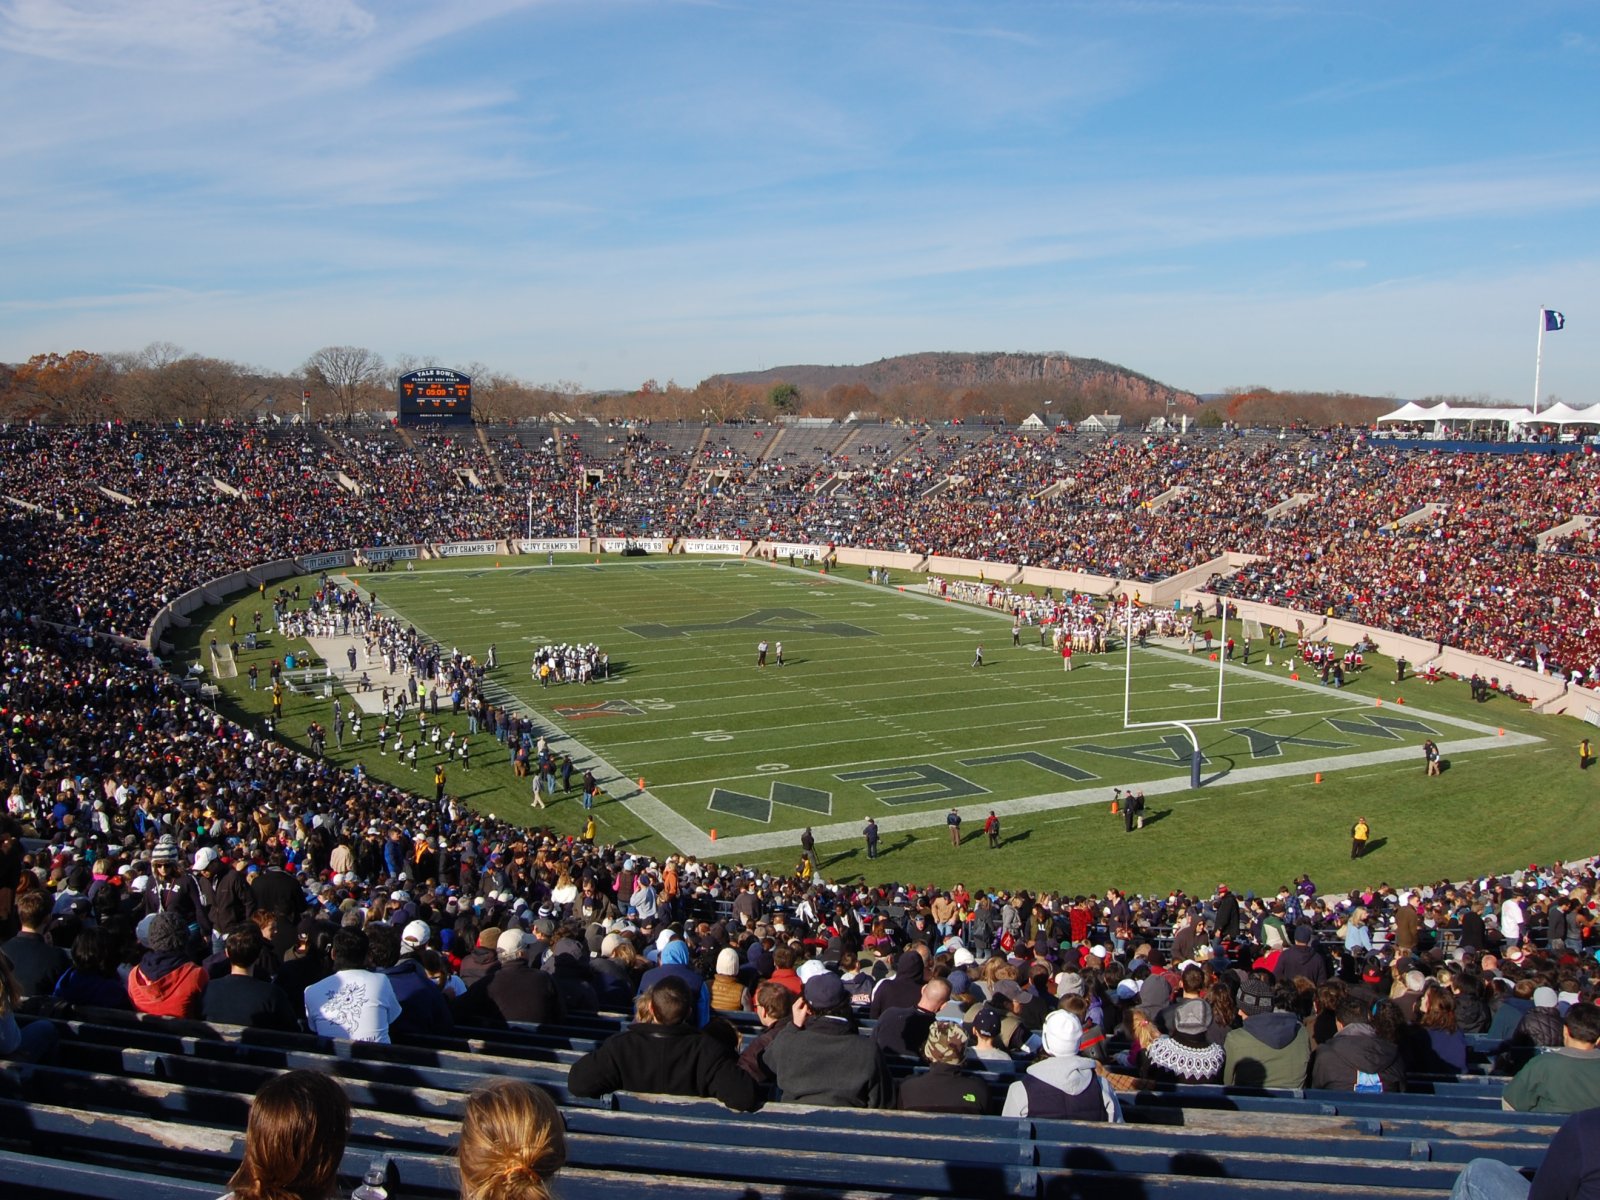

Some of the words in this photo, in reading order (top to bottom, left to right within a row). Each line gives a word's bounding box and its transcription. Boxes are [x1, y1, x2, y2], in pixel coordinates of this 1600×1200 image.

[459, 544, 485, 553] CHAMPS
[705, 543, 729, 551] CHAMPS
[634, 697, 676, 711] 20
[692, 729, 735, 742] 10
[756, 763, 790, 771] G
[831, 726, 1363, 806] YALE
[151, 882, 181, 894] YALE
